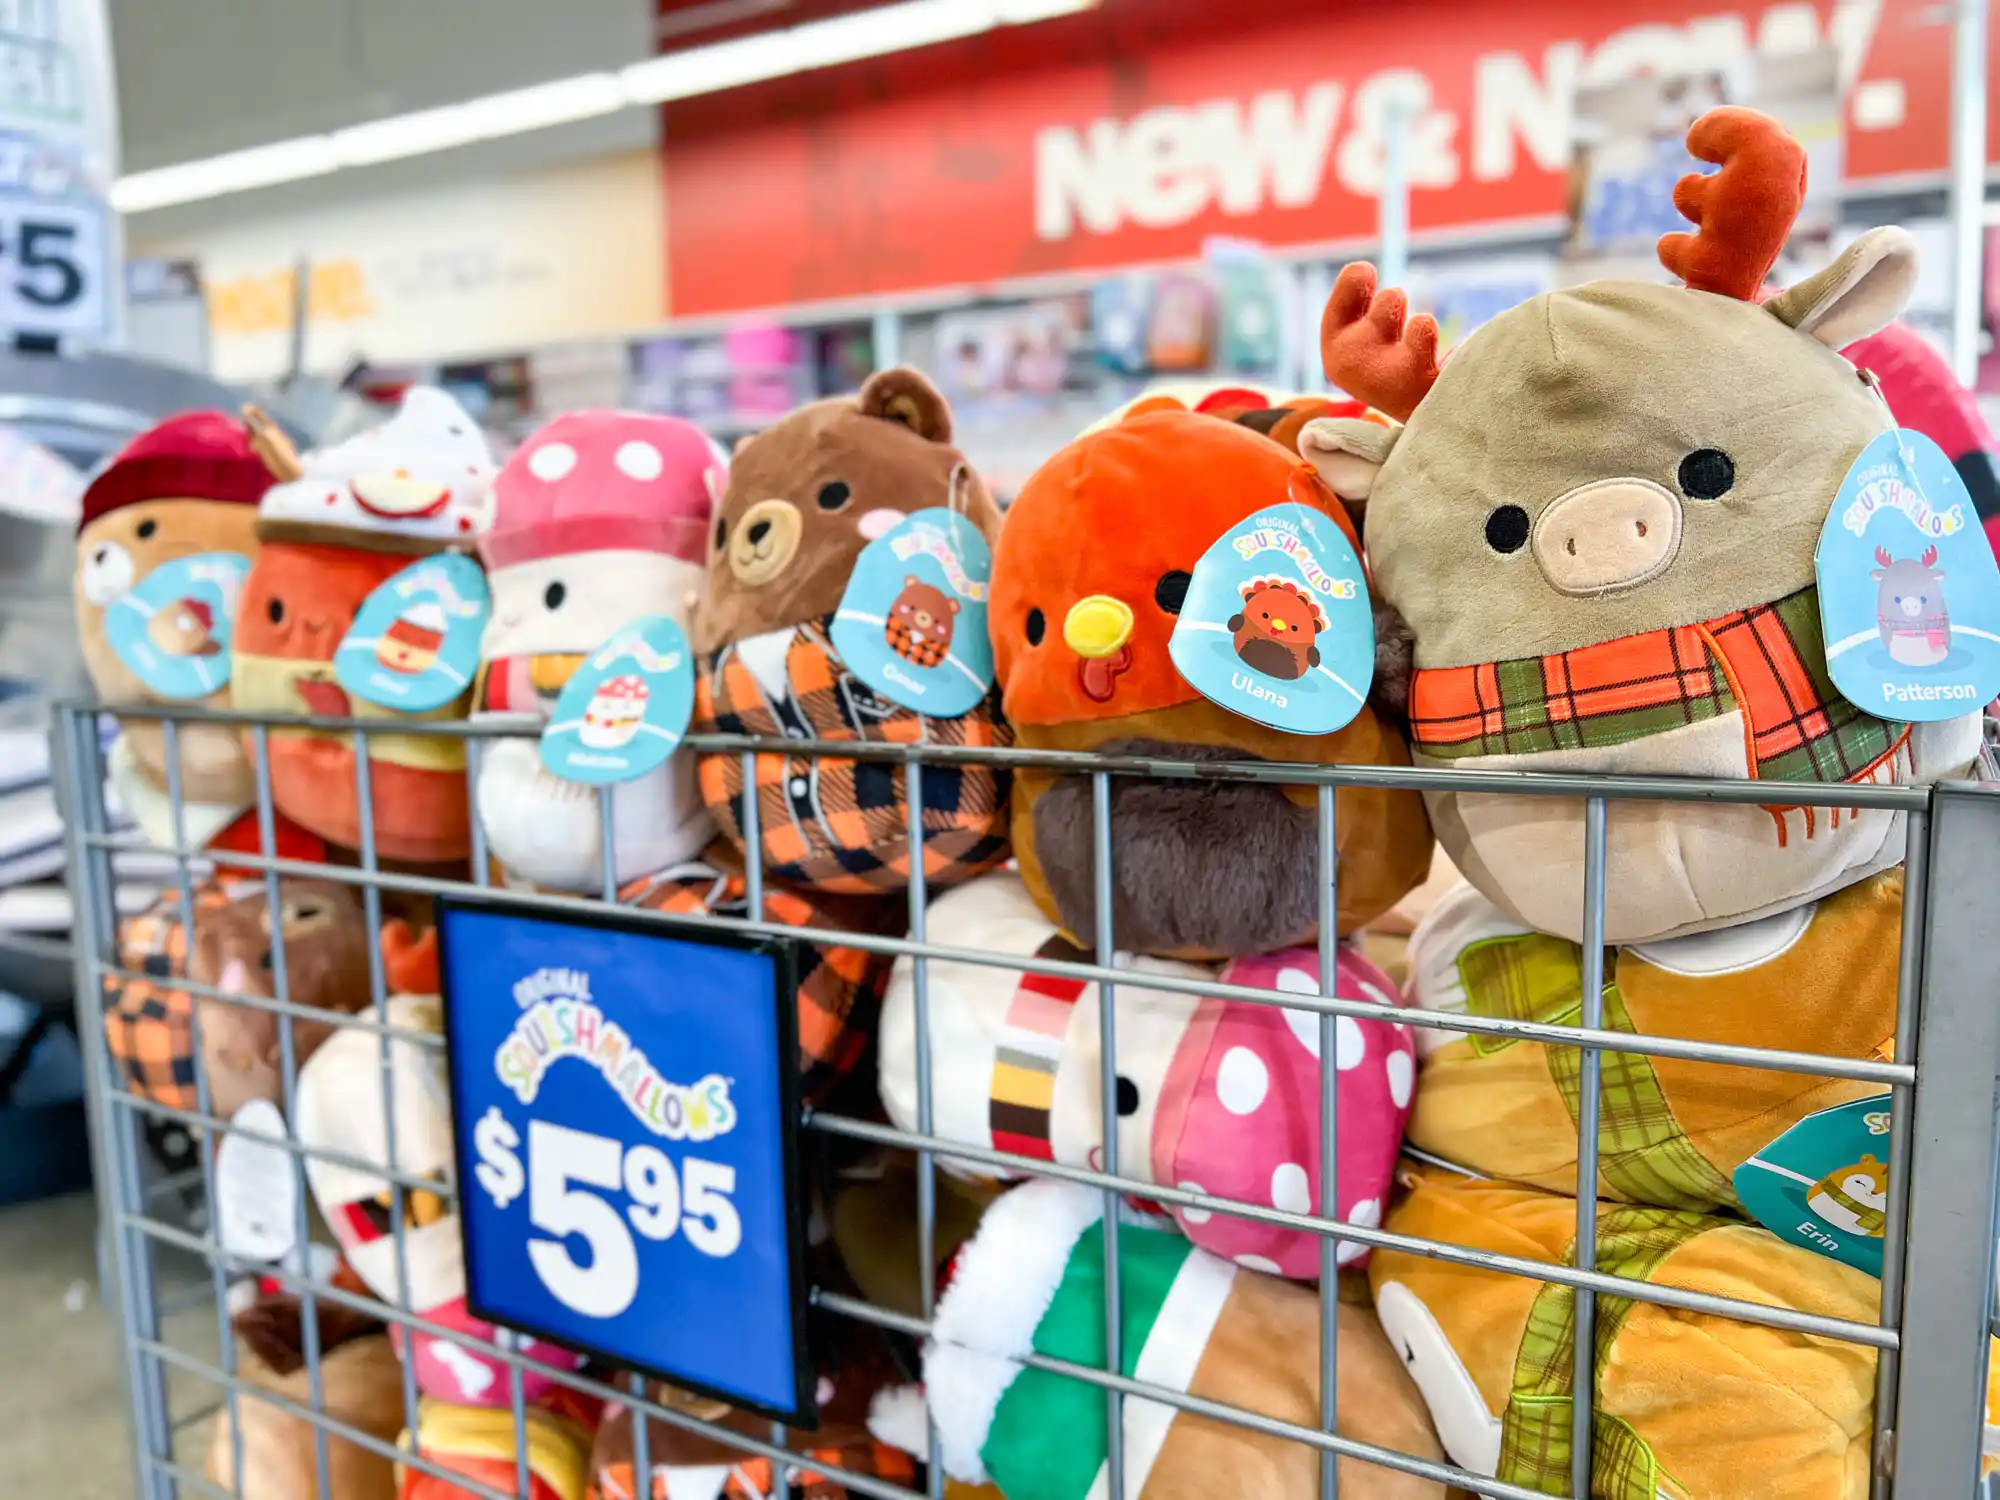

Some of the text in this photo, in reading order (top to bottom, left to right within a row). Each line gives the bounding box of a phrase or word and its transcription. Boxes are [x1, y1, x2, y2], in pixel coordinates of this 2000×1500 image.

[1336, 67, 1460, 197] &
[0, 220, 84, 309] 5
[1231, 671, 1289, 710] Ulana
[1881, 681, 1978, 703] Patterson
[1796, 1220, 1840, 1253] Erin
